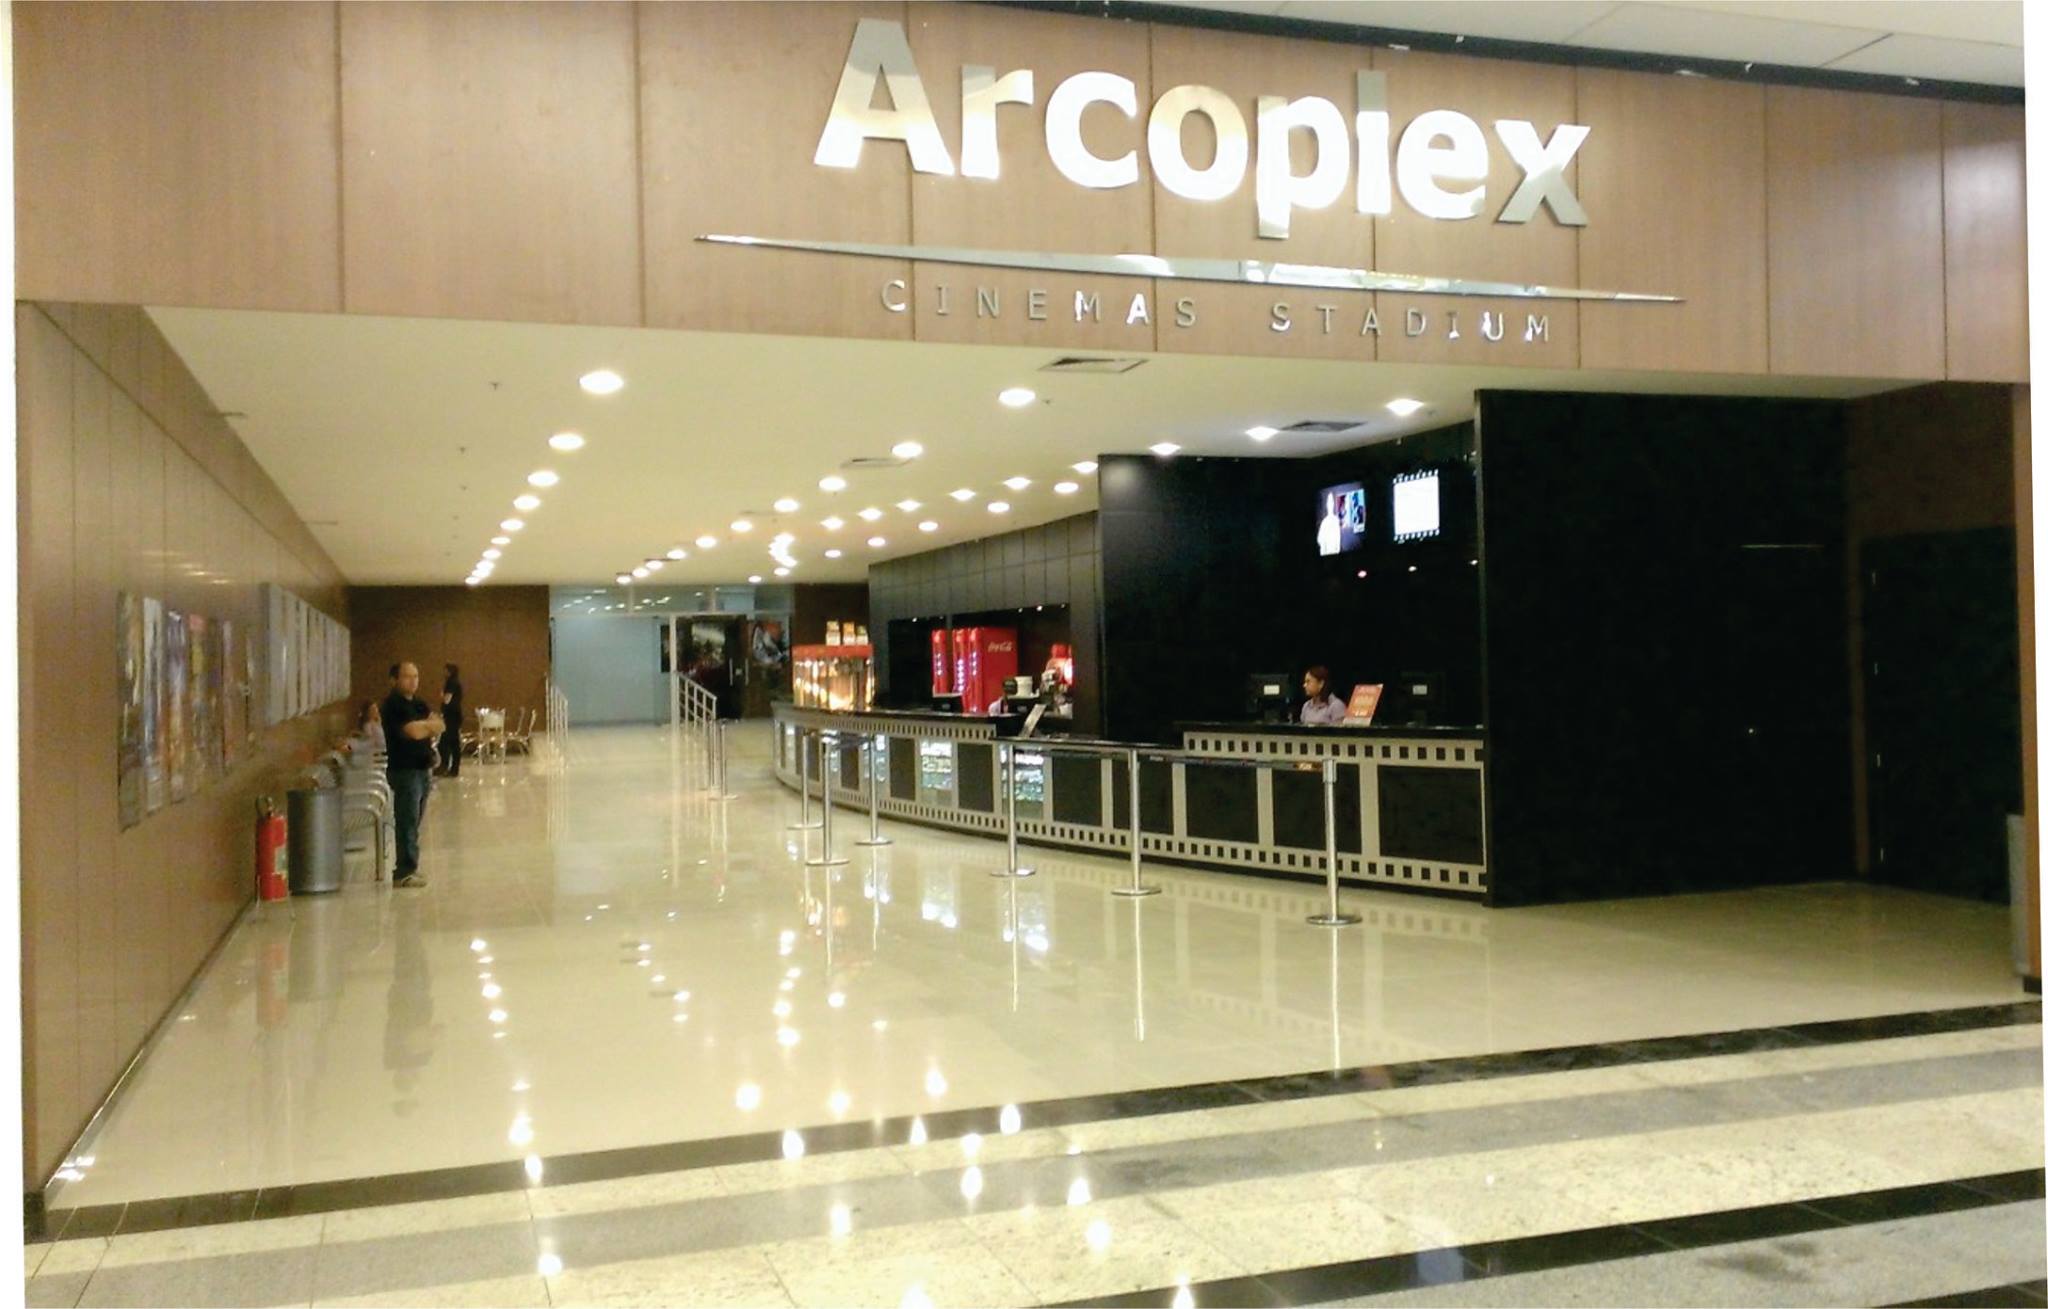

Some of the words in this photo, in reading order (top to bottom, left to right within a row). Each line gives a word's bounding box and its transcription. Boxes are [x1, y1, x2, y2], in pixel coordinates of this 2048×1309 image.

[814, 18, 1591, 239] Arcoplex
[881, 279, 1197, 328] CINEMAS
[1270, 302, 1550, 343] STADIUM
